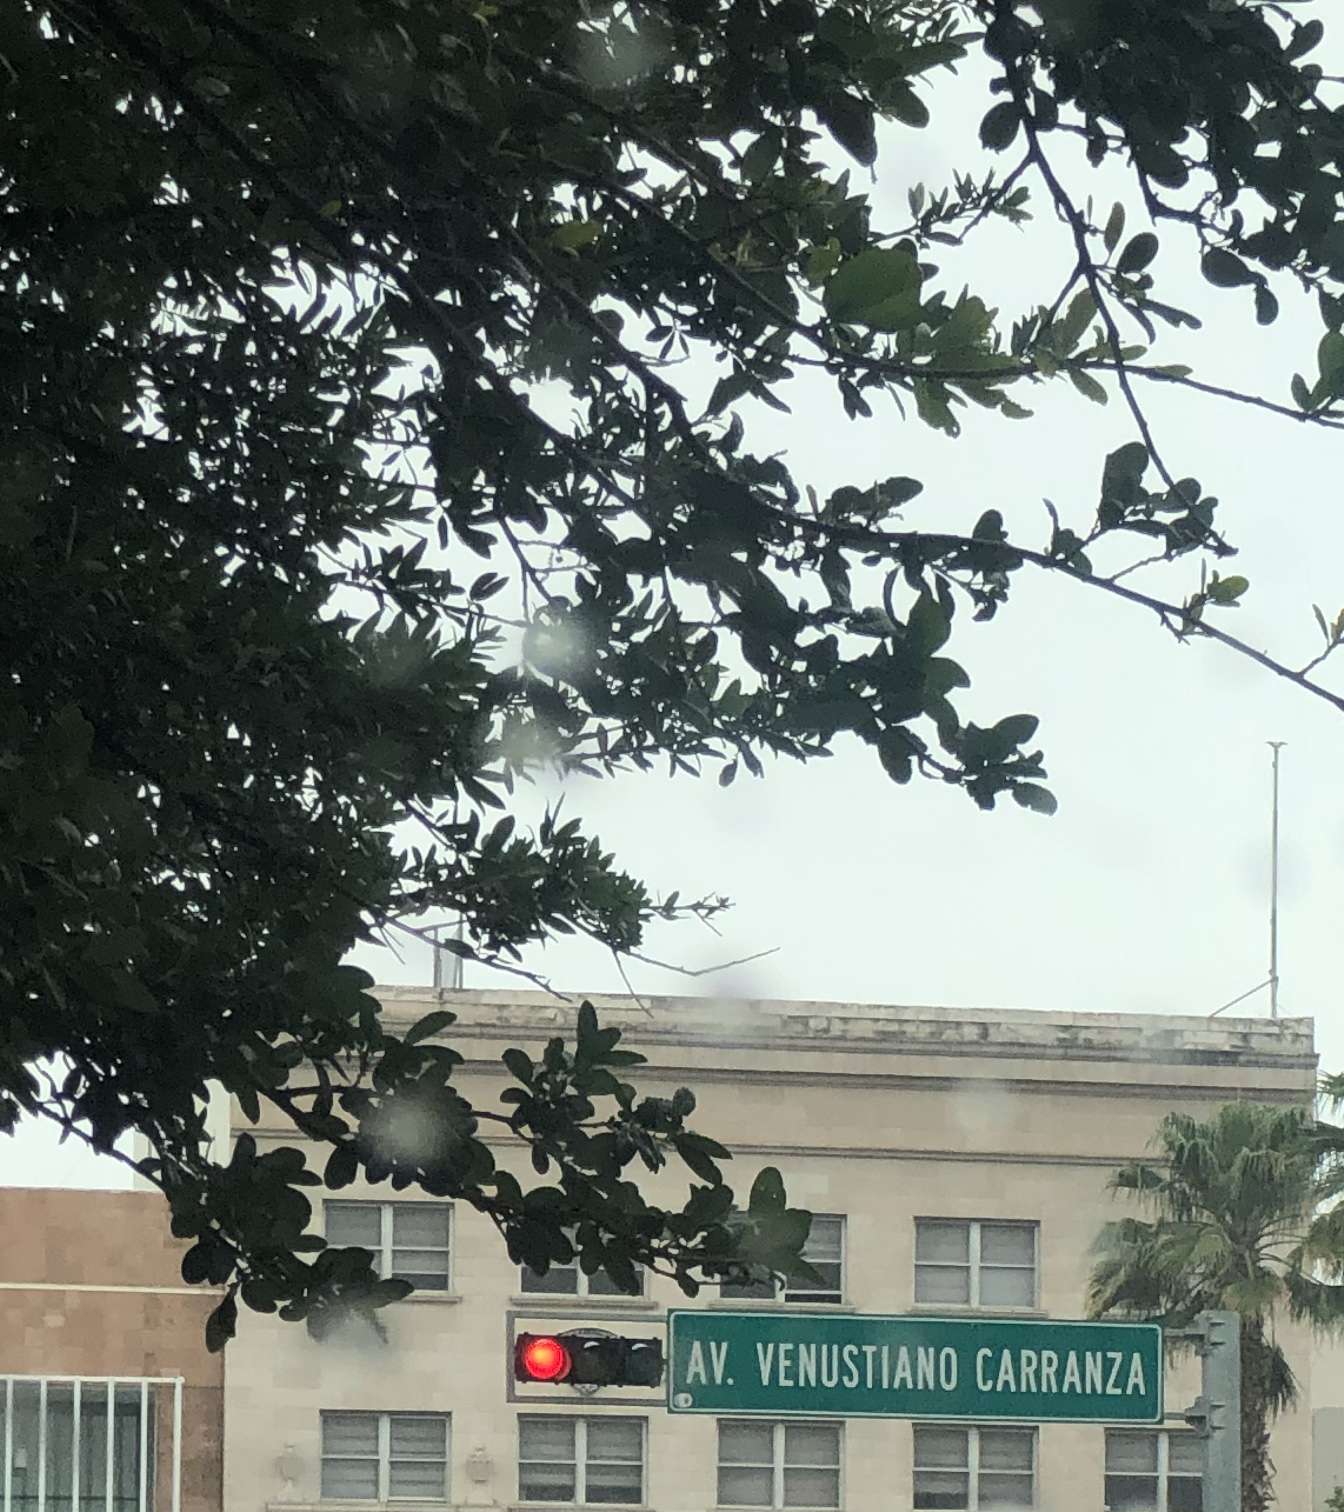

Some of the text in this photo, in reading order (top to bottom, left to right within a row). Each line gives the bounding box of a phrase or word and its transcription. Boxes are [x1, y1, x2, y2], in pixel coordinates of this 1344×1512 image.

[686, 1340, 1147, 1396] AV. VENUSTIANO CARRANZA
